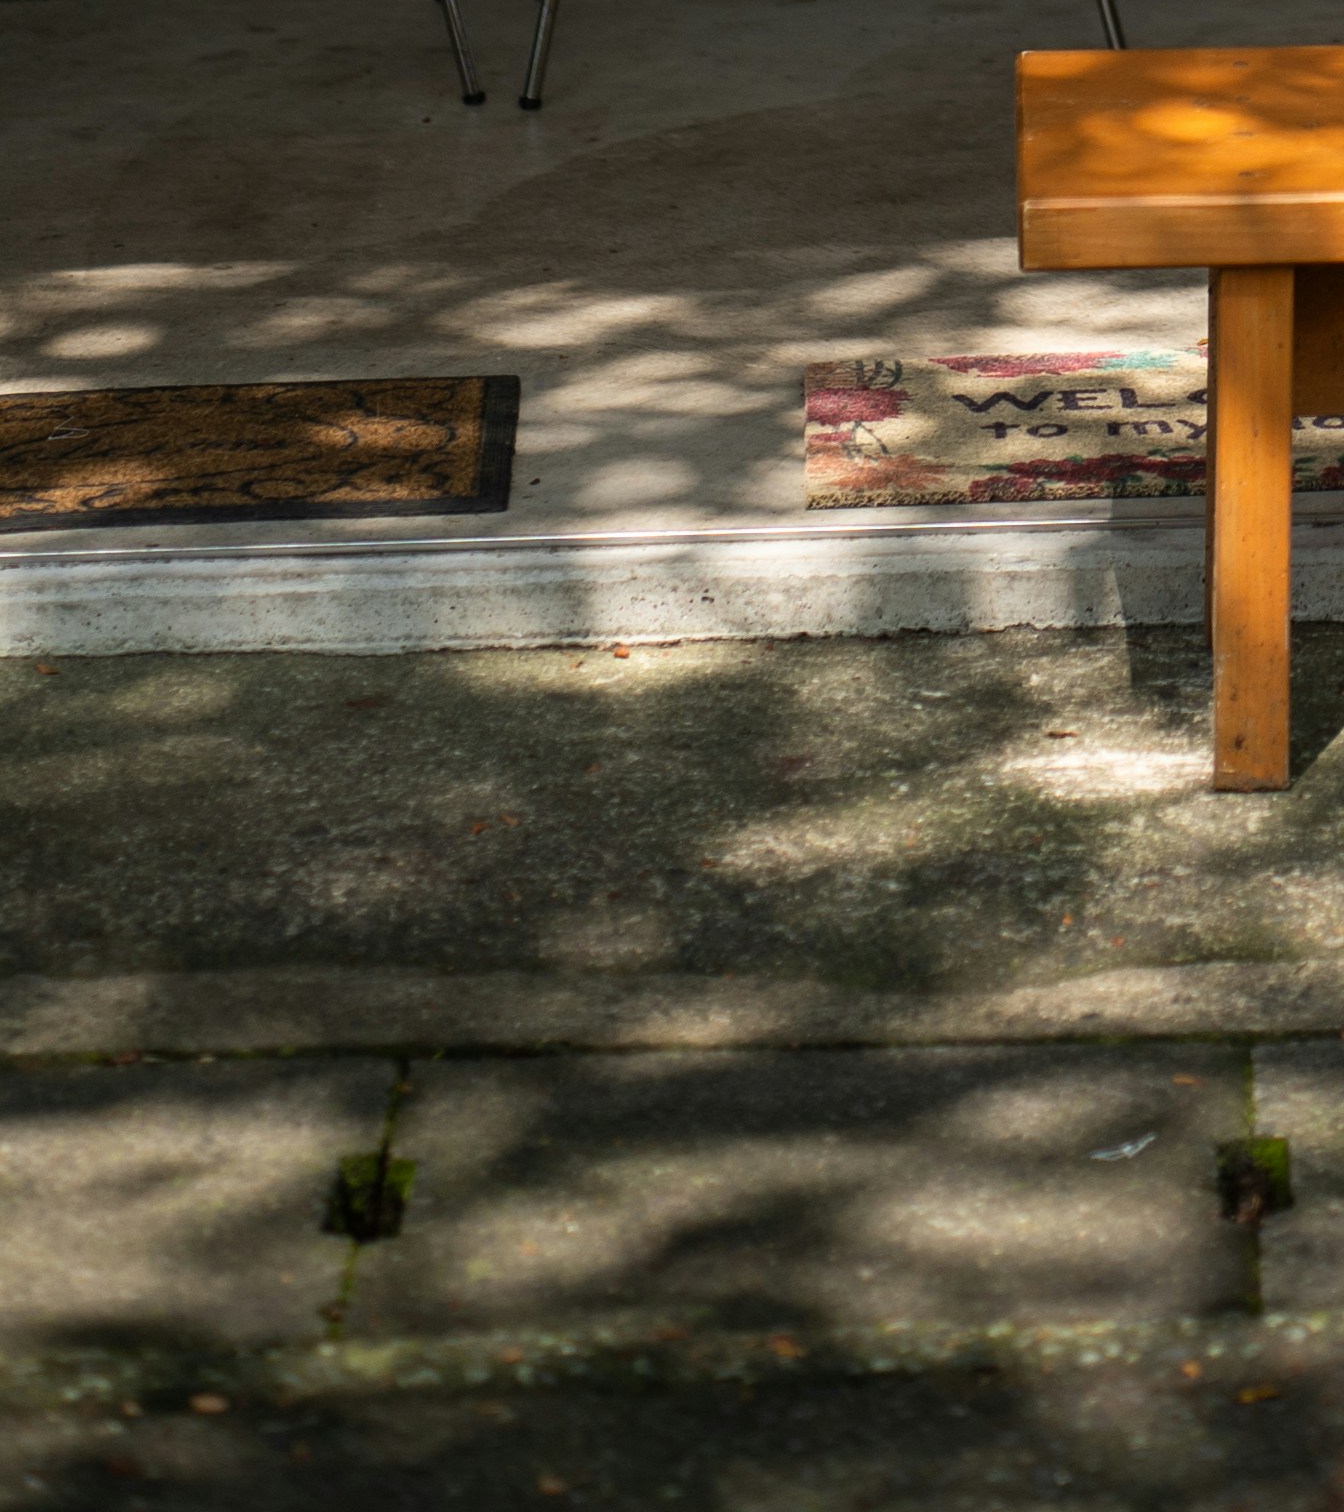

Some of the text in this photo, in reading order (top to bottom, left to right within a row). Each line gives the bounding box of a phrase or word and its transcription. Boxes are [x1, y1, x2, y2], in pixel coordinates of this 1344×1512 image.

[951, 387, 1208, 413] WEL
[980, 420, 1069, 439] to
[1107, 418, 1208, 440] my
